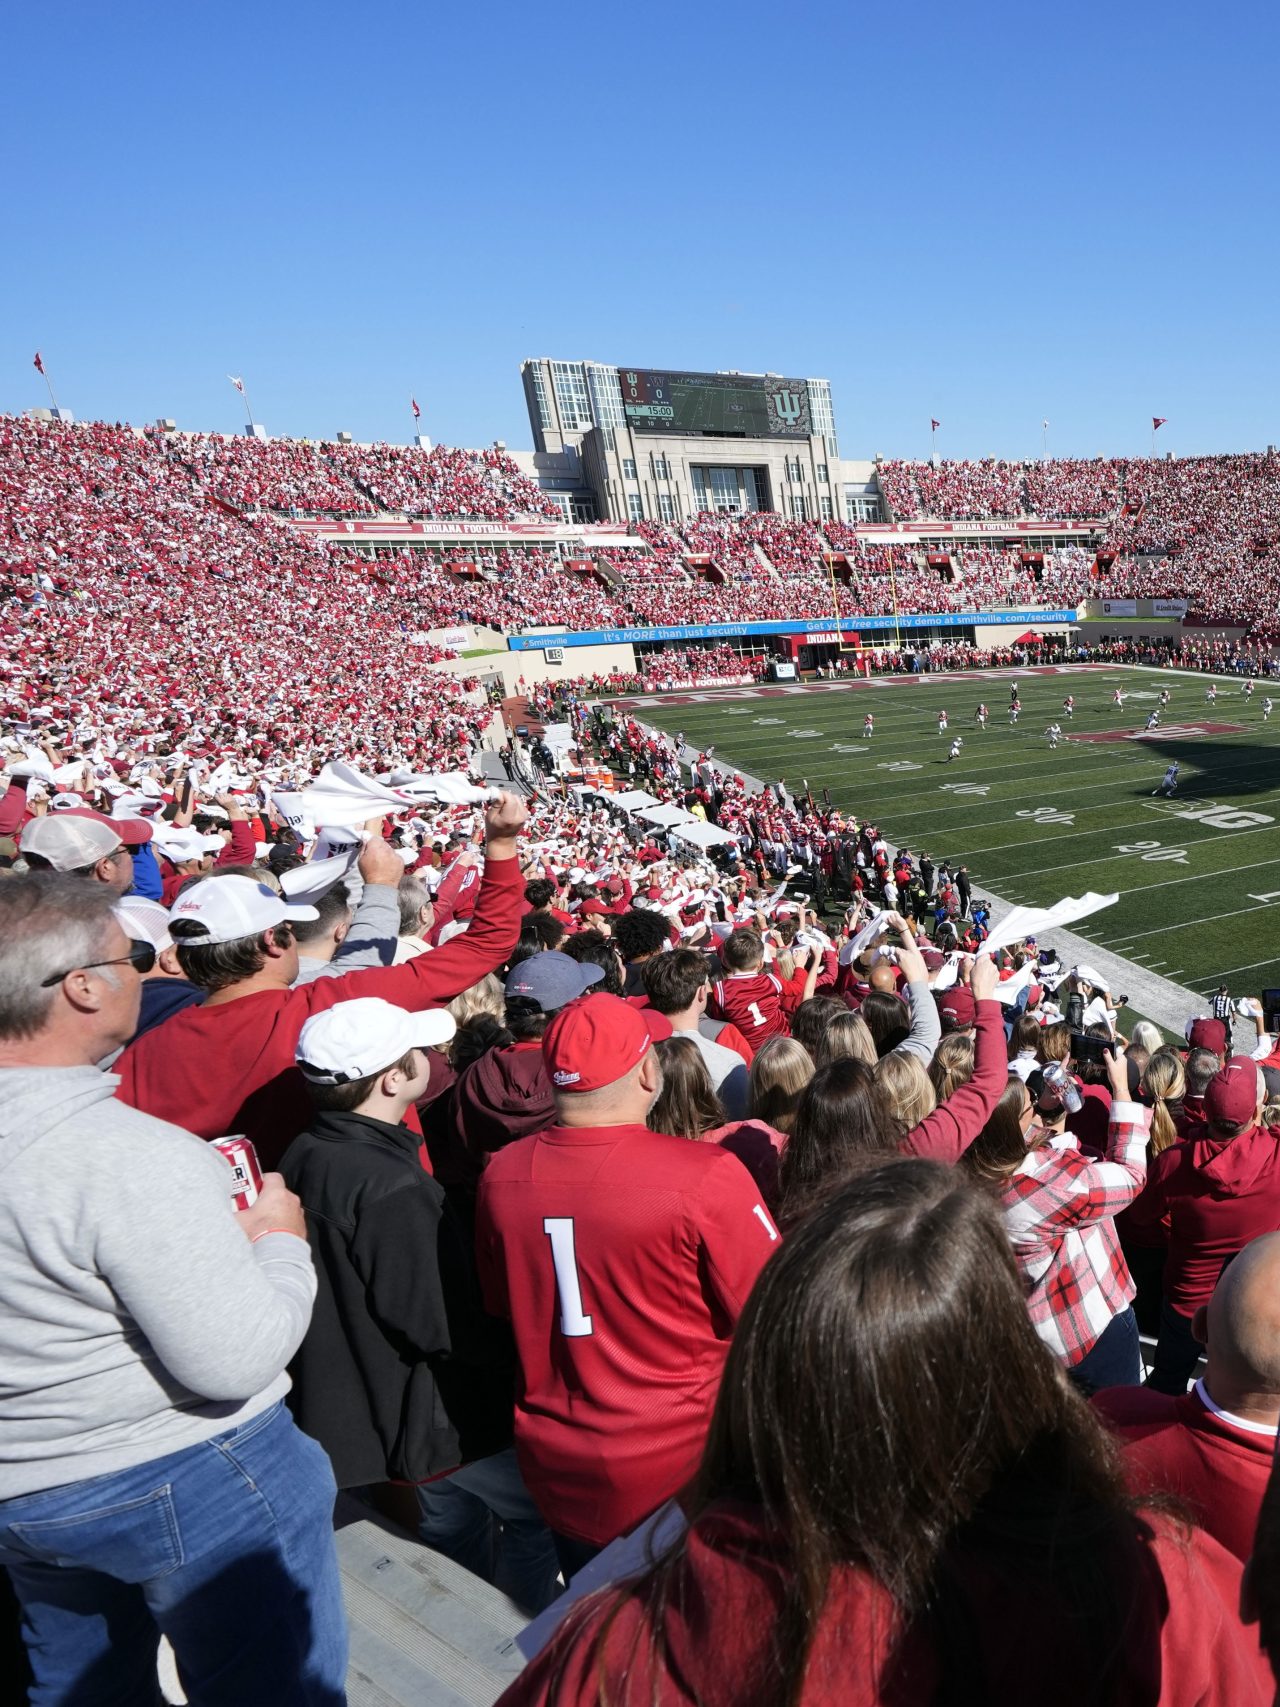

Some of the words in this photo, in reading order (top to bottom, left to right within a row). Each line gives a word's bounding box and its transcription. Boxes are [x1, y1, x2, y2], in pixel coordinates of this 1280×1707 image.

[630, 387, 638, 398] 0
[656, 389, 663, 399] 0
[647, 407, 672, 416] 15:00
[422, 524, 462, 534] INDIANA
[464, 524, 513, 534] FOOTBALL
[952, 523, 981, 531] INDIANA
[982, 523, 1019, 531] FOOTBALL
[807, 622, 825, 631] Get
[827, 622, 849, 631] your
[852, 620, 872, 629] free
[874, 618, 913, 628] security
[944, 617, 954, 625] at
[957, 612, 1068, 624] smithville.com/security
[603, 632, 620, 642] It's
[623, 631, 655, 641] MORE
[658, 629, 682, 639] than
[685, 628, 704, 640] just
[706, 625, 748, 637] security
[806, 634, 845, 644] INDIANA
[529, 637, 568, 647] Smithville
[696, 677, 737, 688] FOOTBALL
[1015, 806, 1075, 826] 30
[1111, 840, 1190, 865] 20
[747, 1001, 768, 1027] 1
[753, 1204, 778, 1241] 1
[542, 1216, 594, 1337] 1
